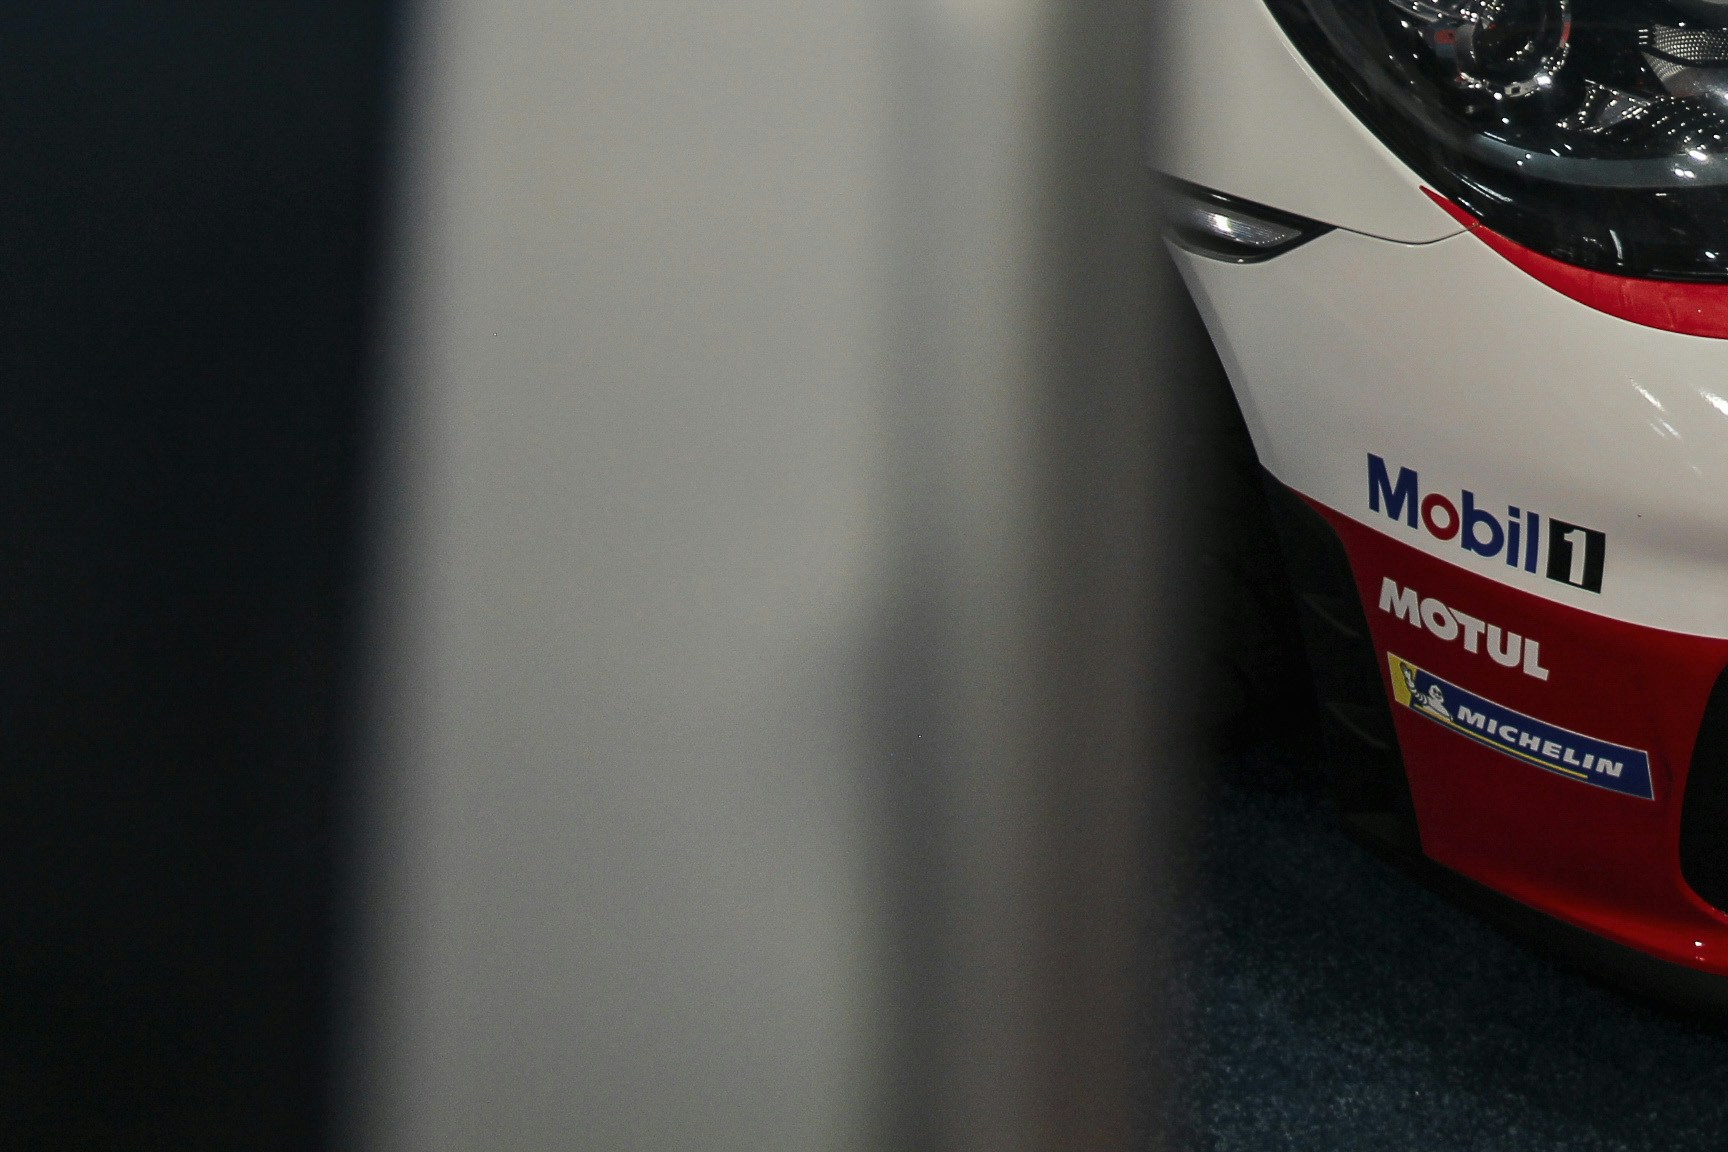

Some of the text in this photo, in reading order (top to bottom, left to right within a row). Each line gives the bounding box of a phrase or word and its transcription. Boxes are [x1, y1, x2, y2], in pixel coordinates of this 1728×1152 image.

[1366, 452, 1540, 575] Mobil
[1378, 577, 1549, 681] MOTUL
[1457, 705, 1623, 778] MICHELIN
